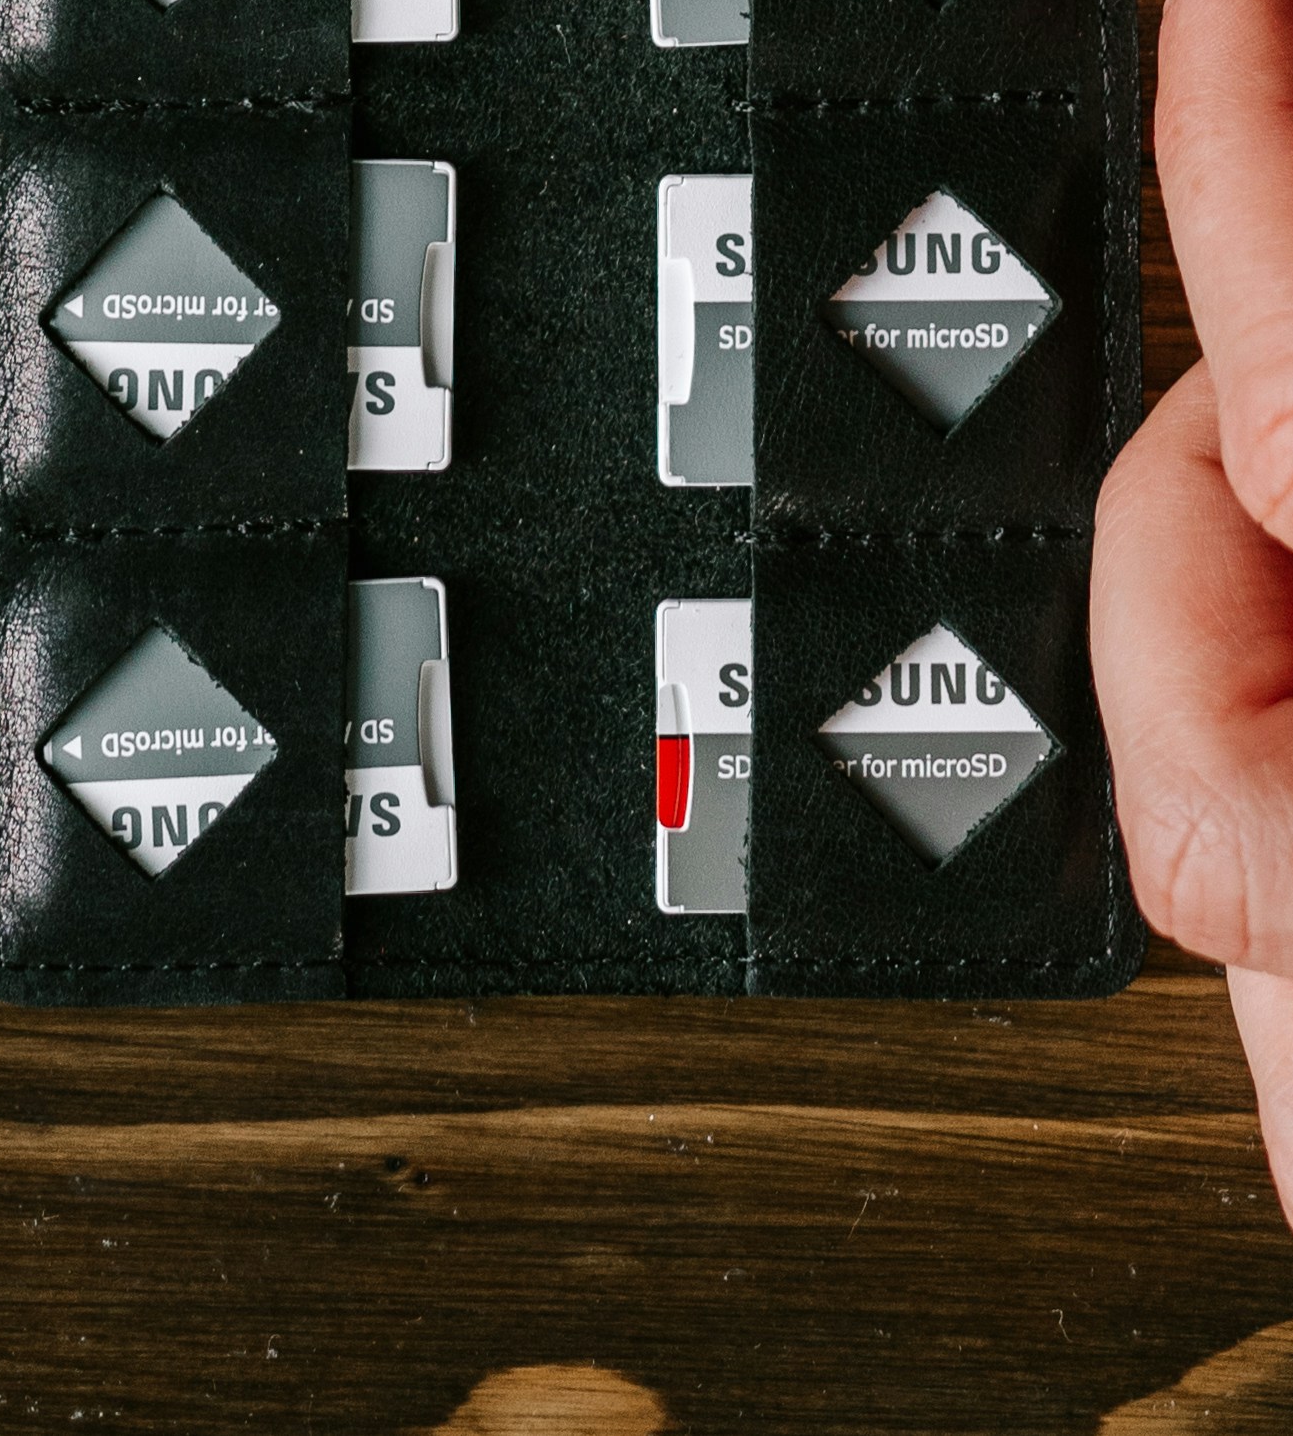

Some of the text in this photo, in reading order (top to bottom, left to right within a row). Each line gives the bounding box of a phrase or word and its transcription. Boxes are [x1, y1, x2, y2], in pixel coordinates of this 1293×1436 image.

[102, 294, 249, 322] for microSD
[864, 322, 1009, 349] for microSD
[100, 726, 248, 758] for microSD
[861, 753, 1007, 779] for microSD
